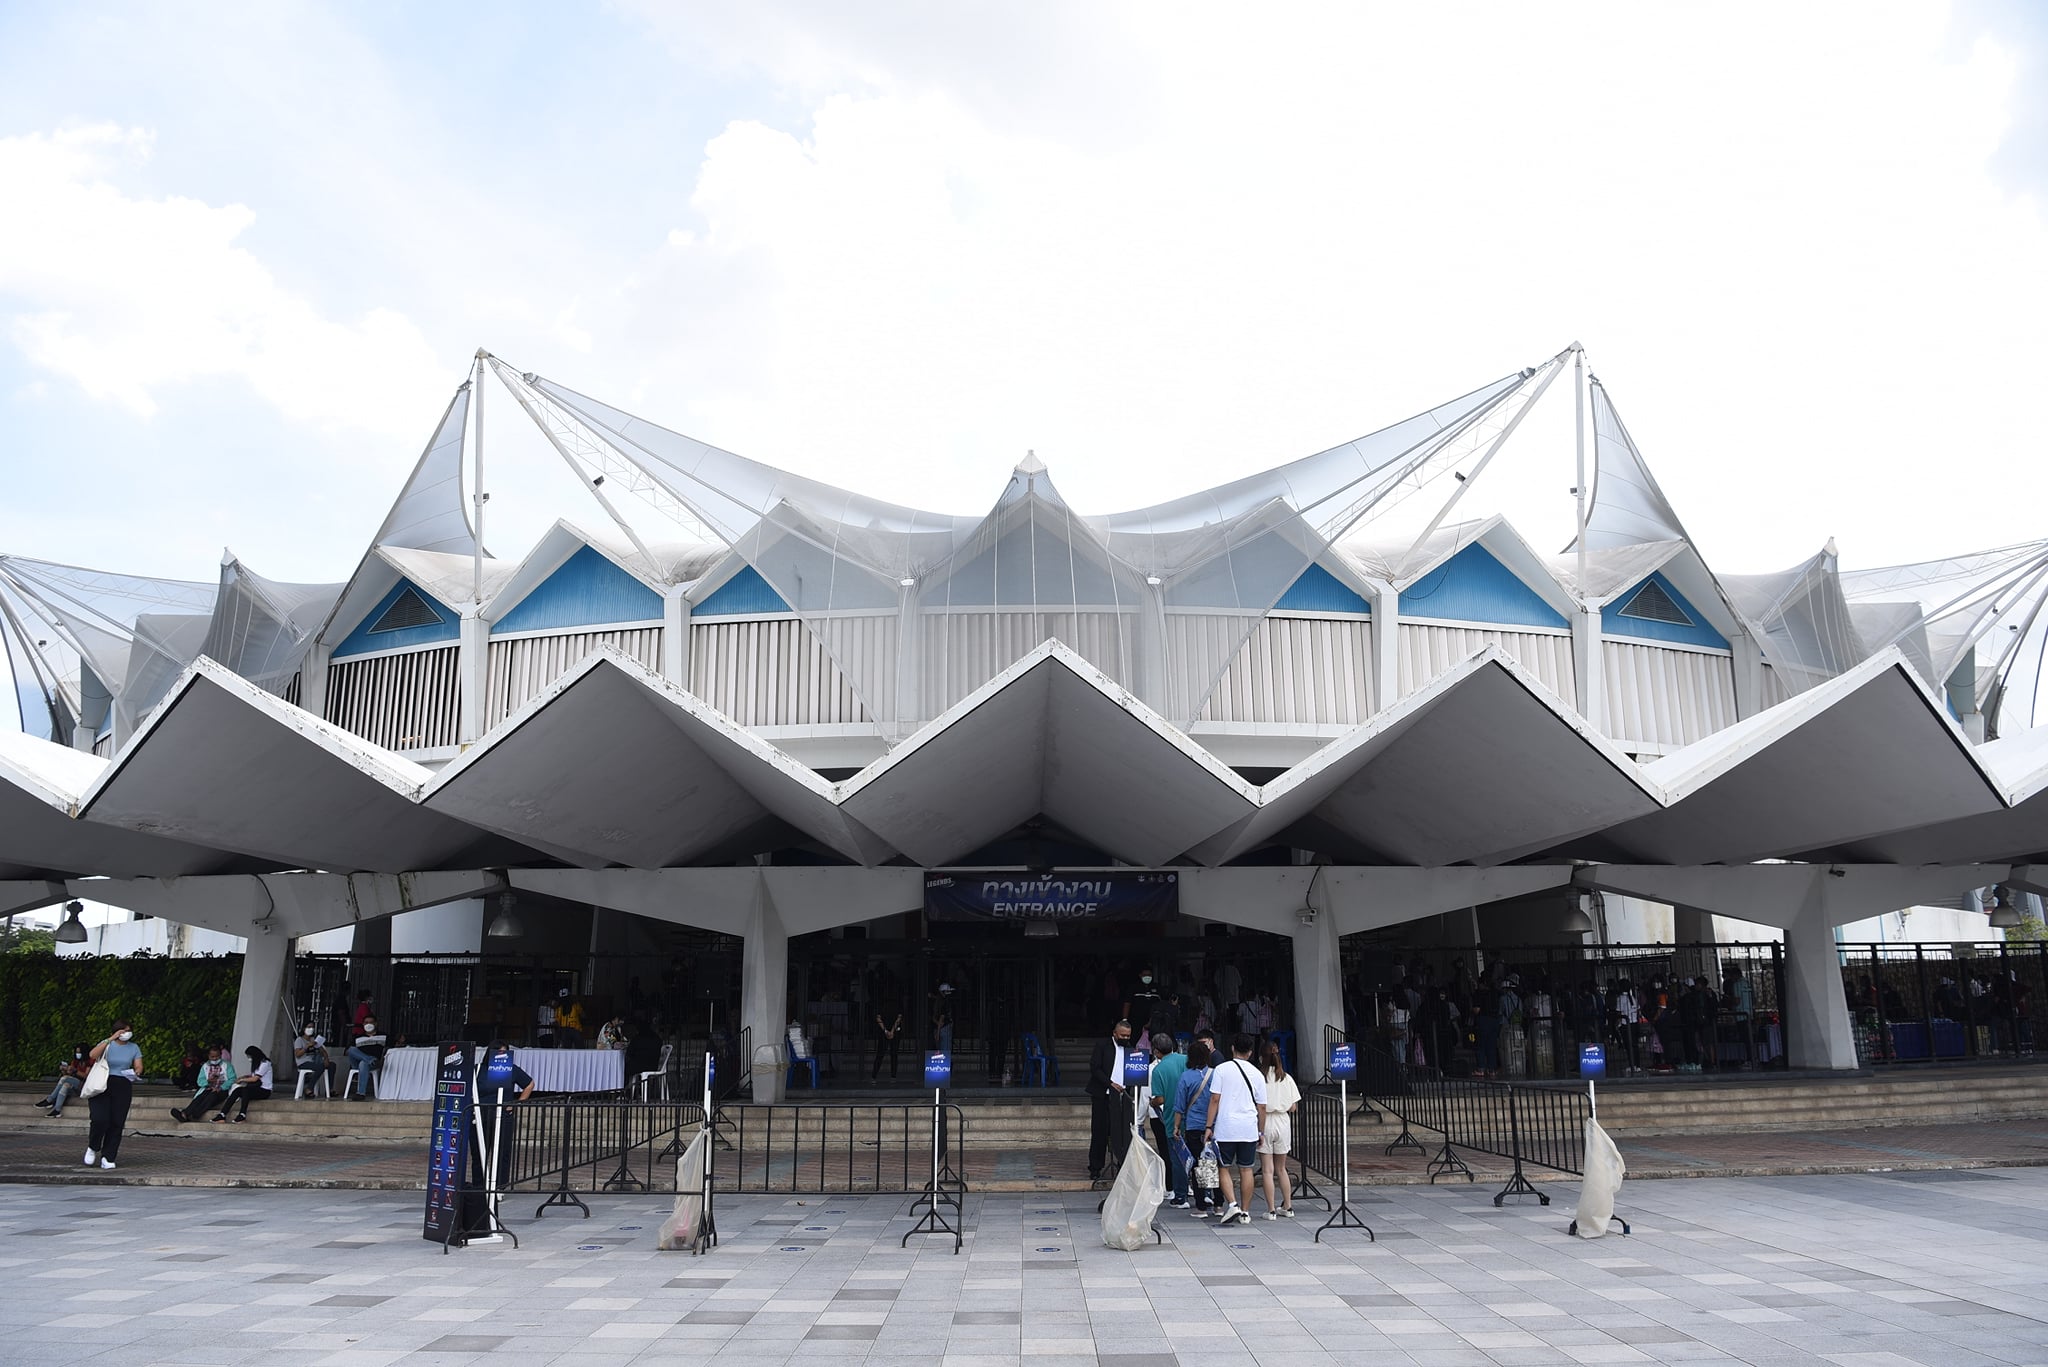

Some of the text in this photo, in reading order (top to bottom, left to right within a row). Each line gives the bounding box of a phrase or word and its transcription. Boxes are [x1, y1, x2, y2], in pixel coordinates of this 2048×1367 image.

[982, 874, 1111, 898] ทางเข้างาน
[992, 902, 1097, 917] ENTRANCE
[1125, 1063, 1148, 1071] PRESS
